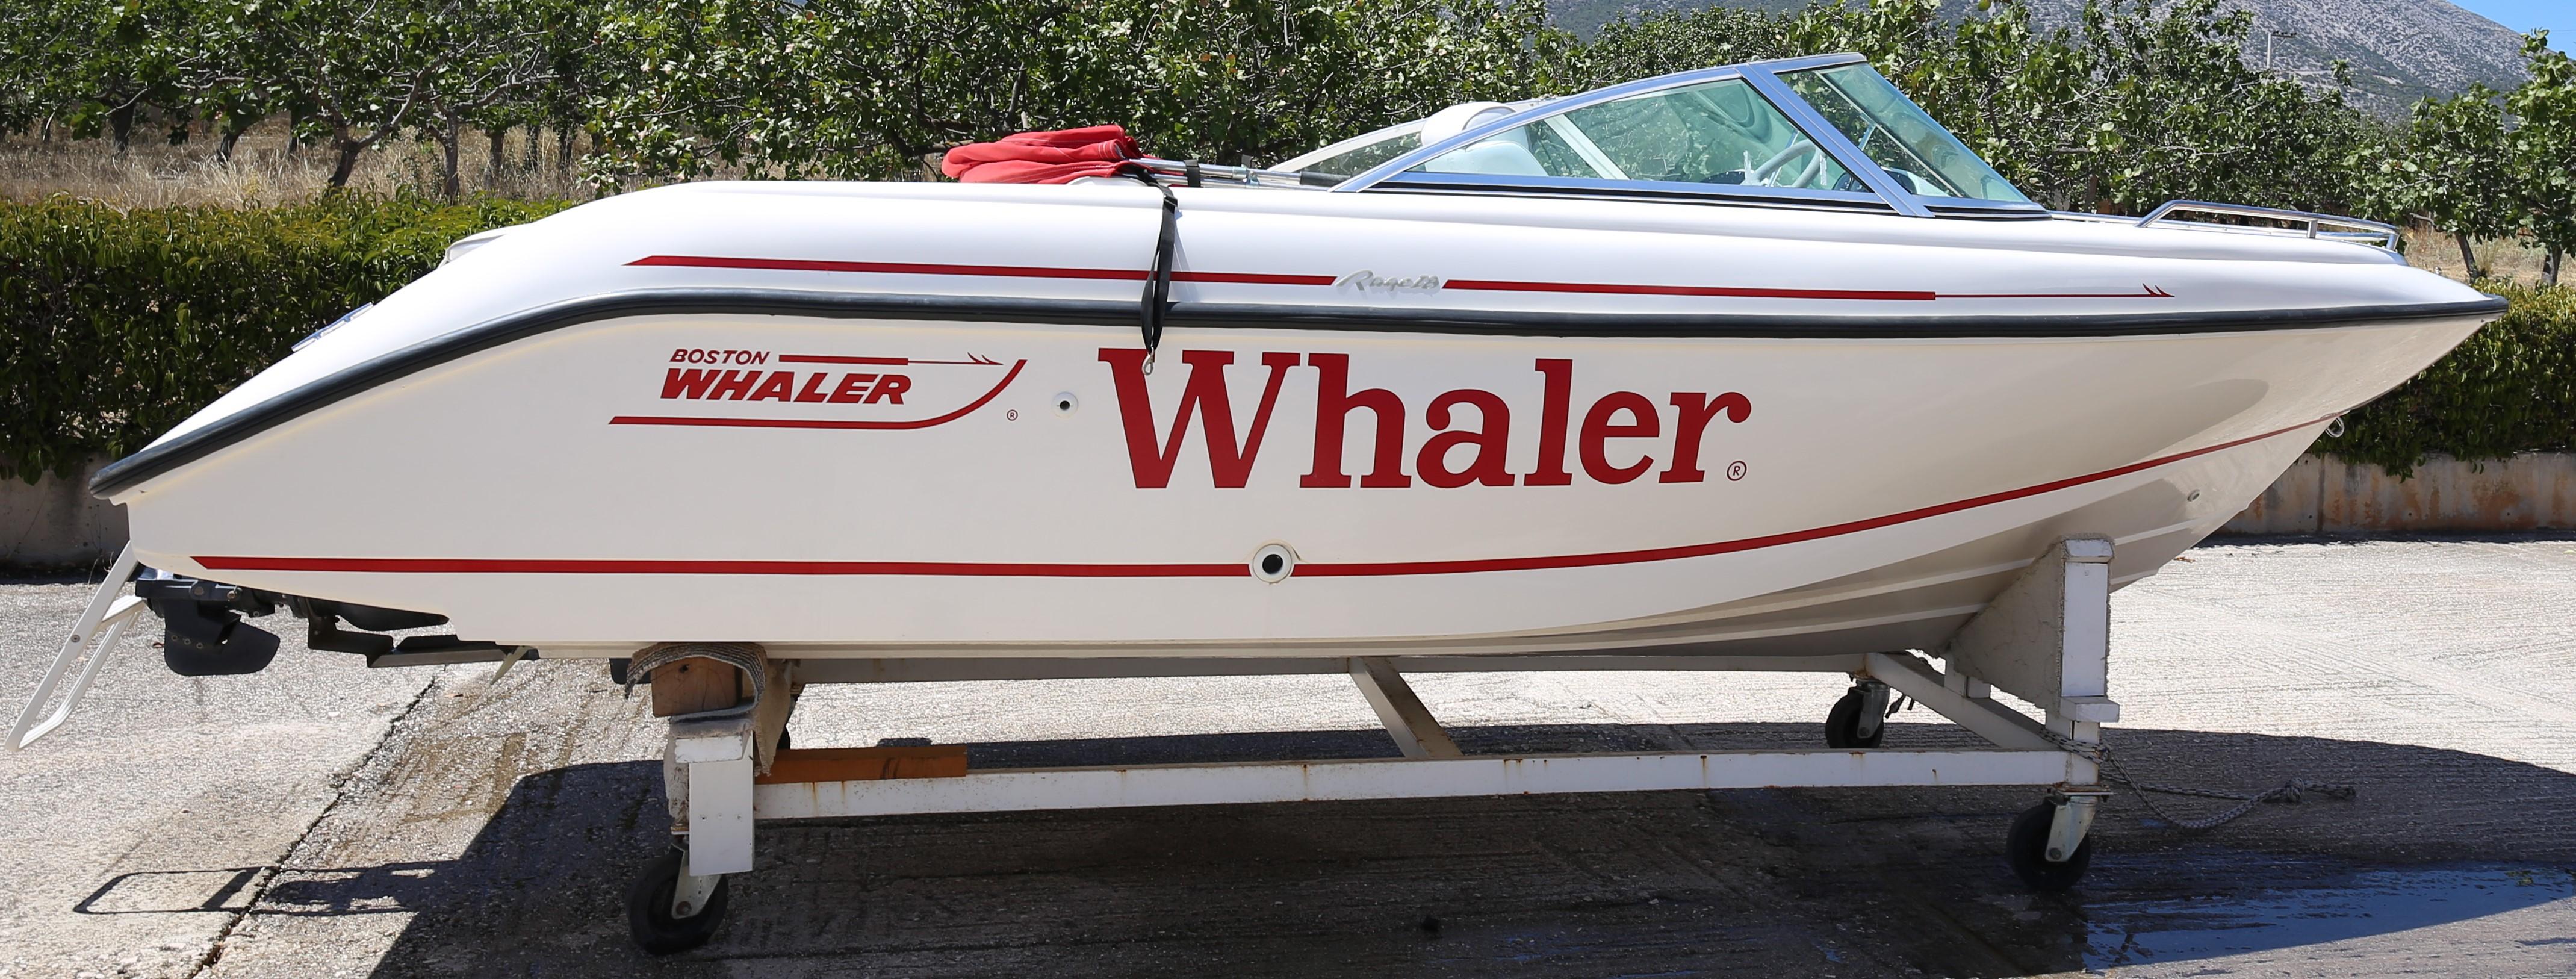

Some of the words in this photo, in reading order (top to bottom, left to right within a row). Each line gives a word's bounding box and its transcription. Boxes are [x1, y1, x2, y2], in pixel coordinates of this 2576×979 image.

[669, 348, 770, 365] BOSTON
[660, 367, 912, 405] WHALER
[1097, 347, 1752, 489] Whaler
